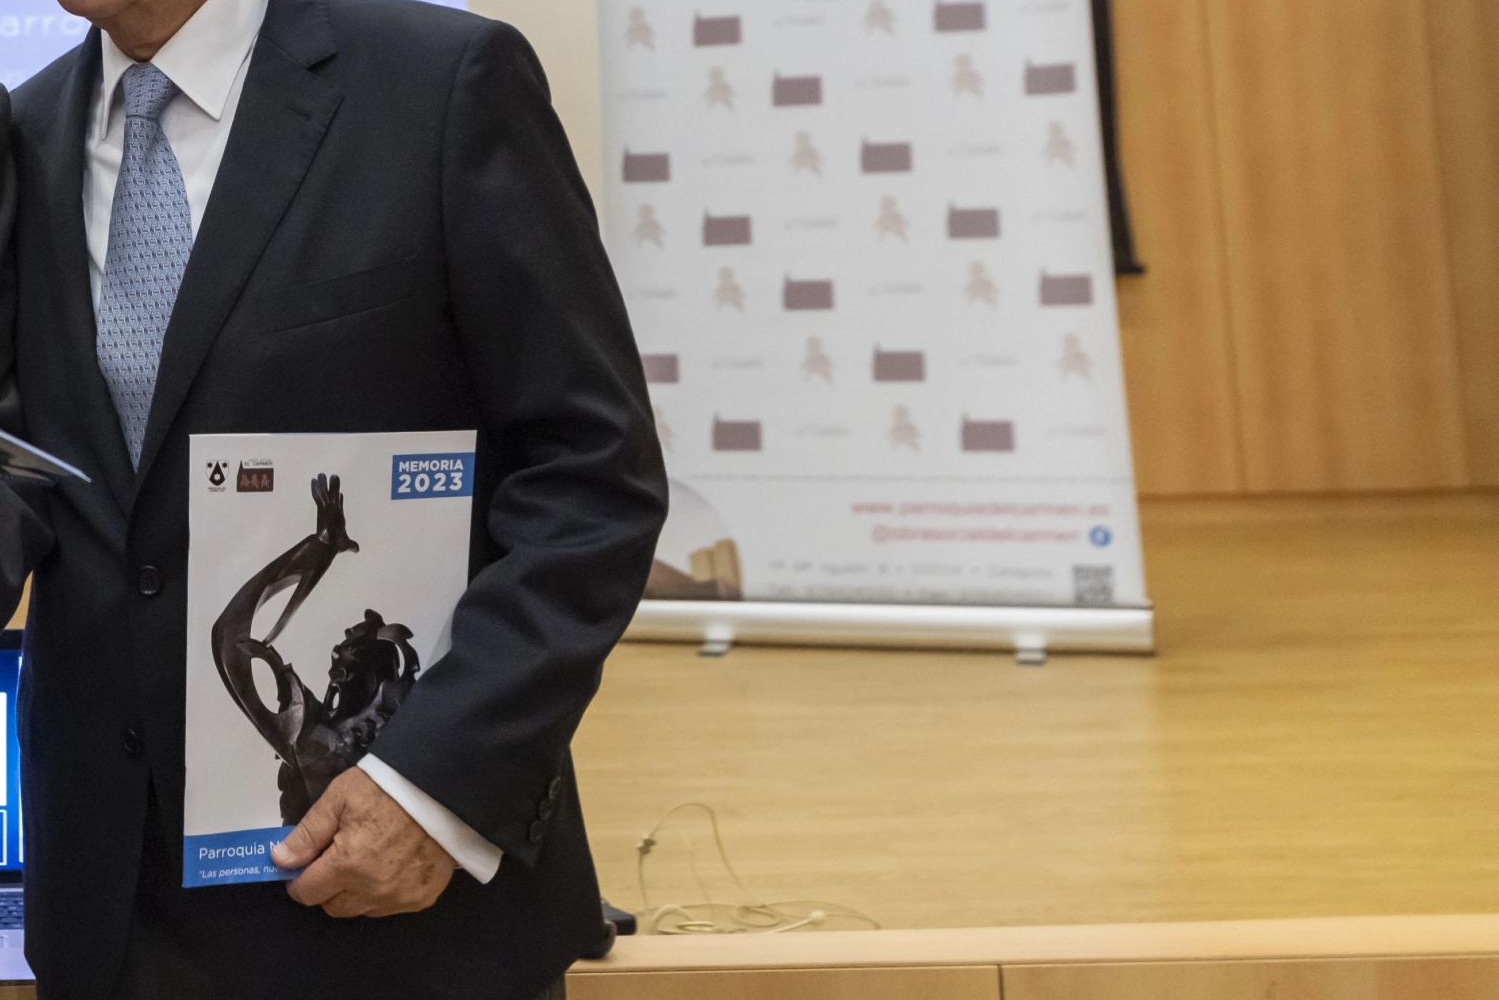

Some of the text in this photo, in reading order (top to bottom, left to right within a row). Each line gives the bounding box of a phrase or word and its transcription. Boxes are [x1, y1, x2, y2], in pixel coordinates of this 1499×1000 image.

[398, 459, 463, 473] MEMORIA
[397, 472, 463, 493] 2023
[199, 842, 265, 860] Parroquia
[218, 867, 261, 878] personas,
